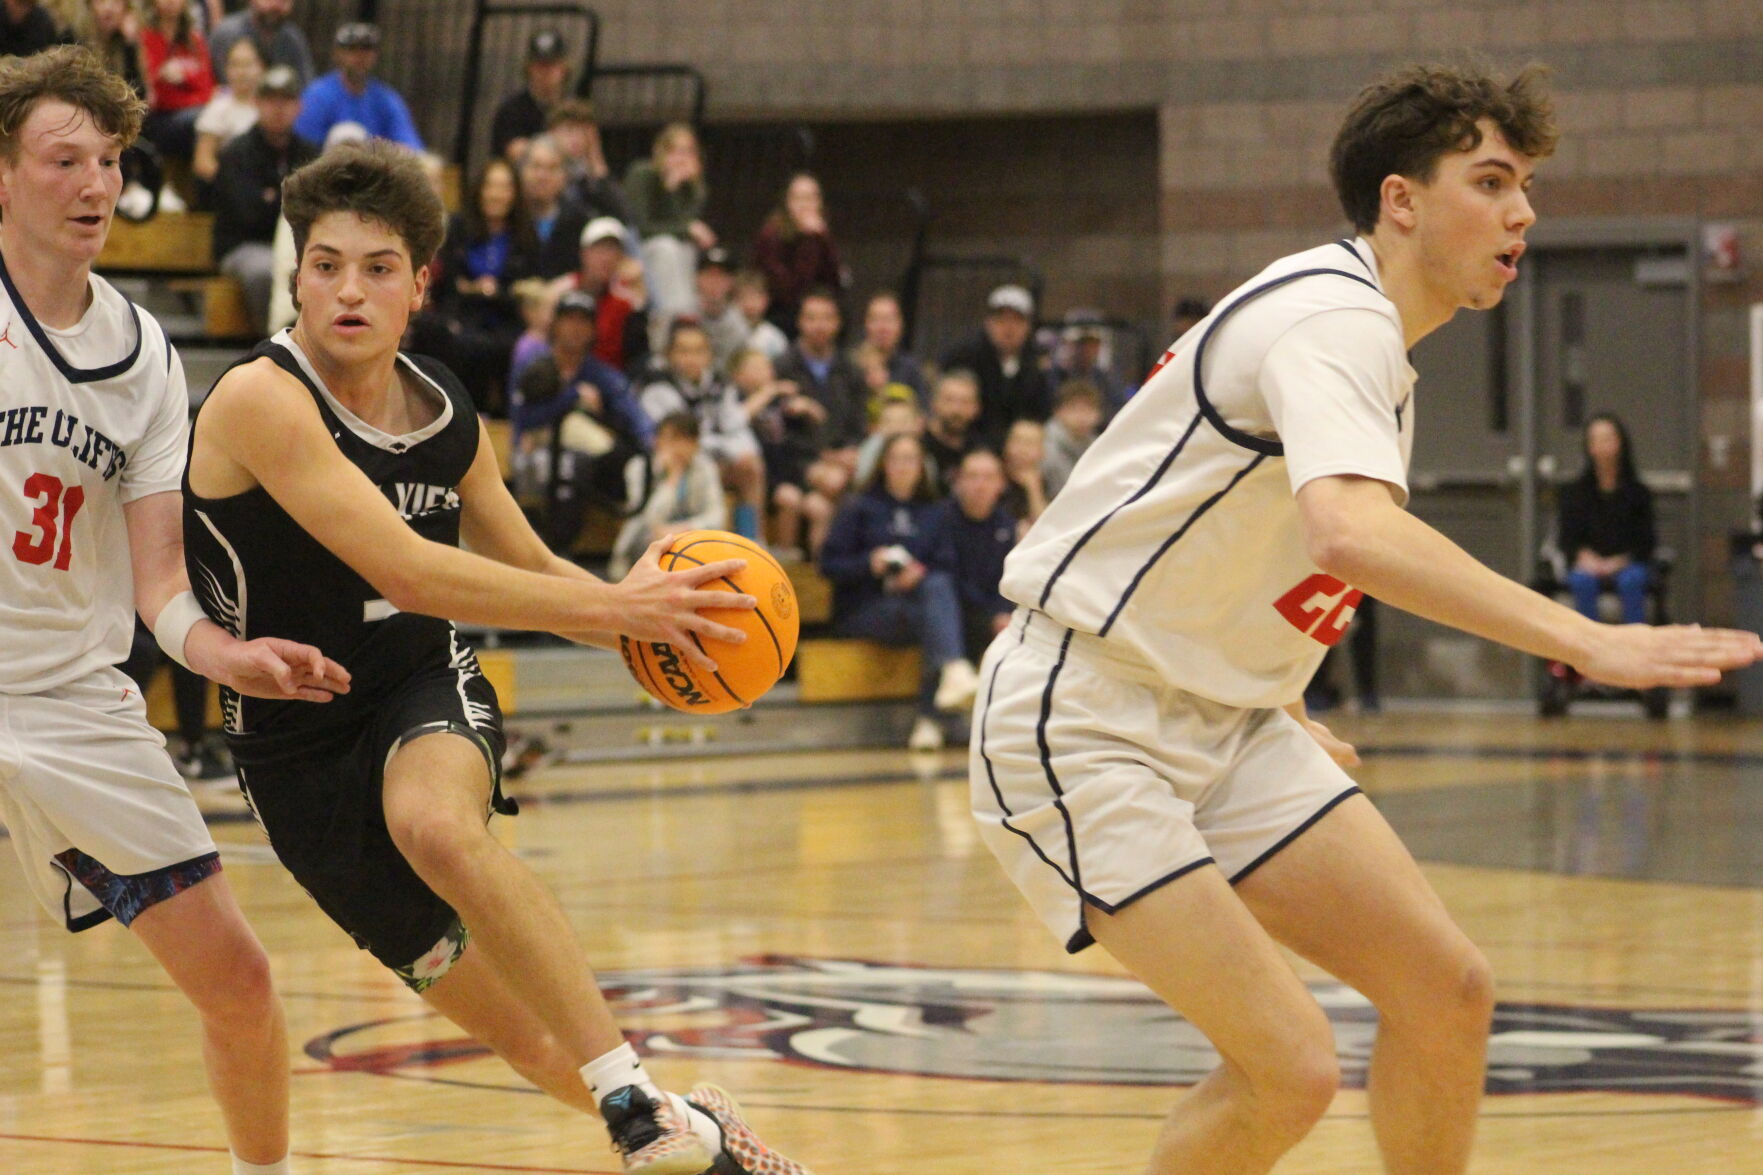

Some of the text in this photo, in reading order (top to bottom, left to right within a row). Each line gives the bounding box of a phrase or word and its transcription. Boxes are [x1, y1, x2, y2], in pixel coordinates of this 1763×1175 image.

[0, 406, 48, 447] HE
[12, 472, 85, 571] 31
[651, 642, 711, 705] NCAA
